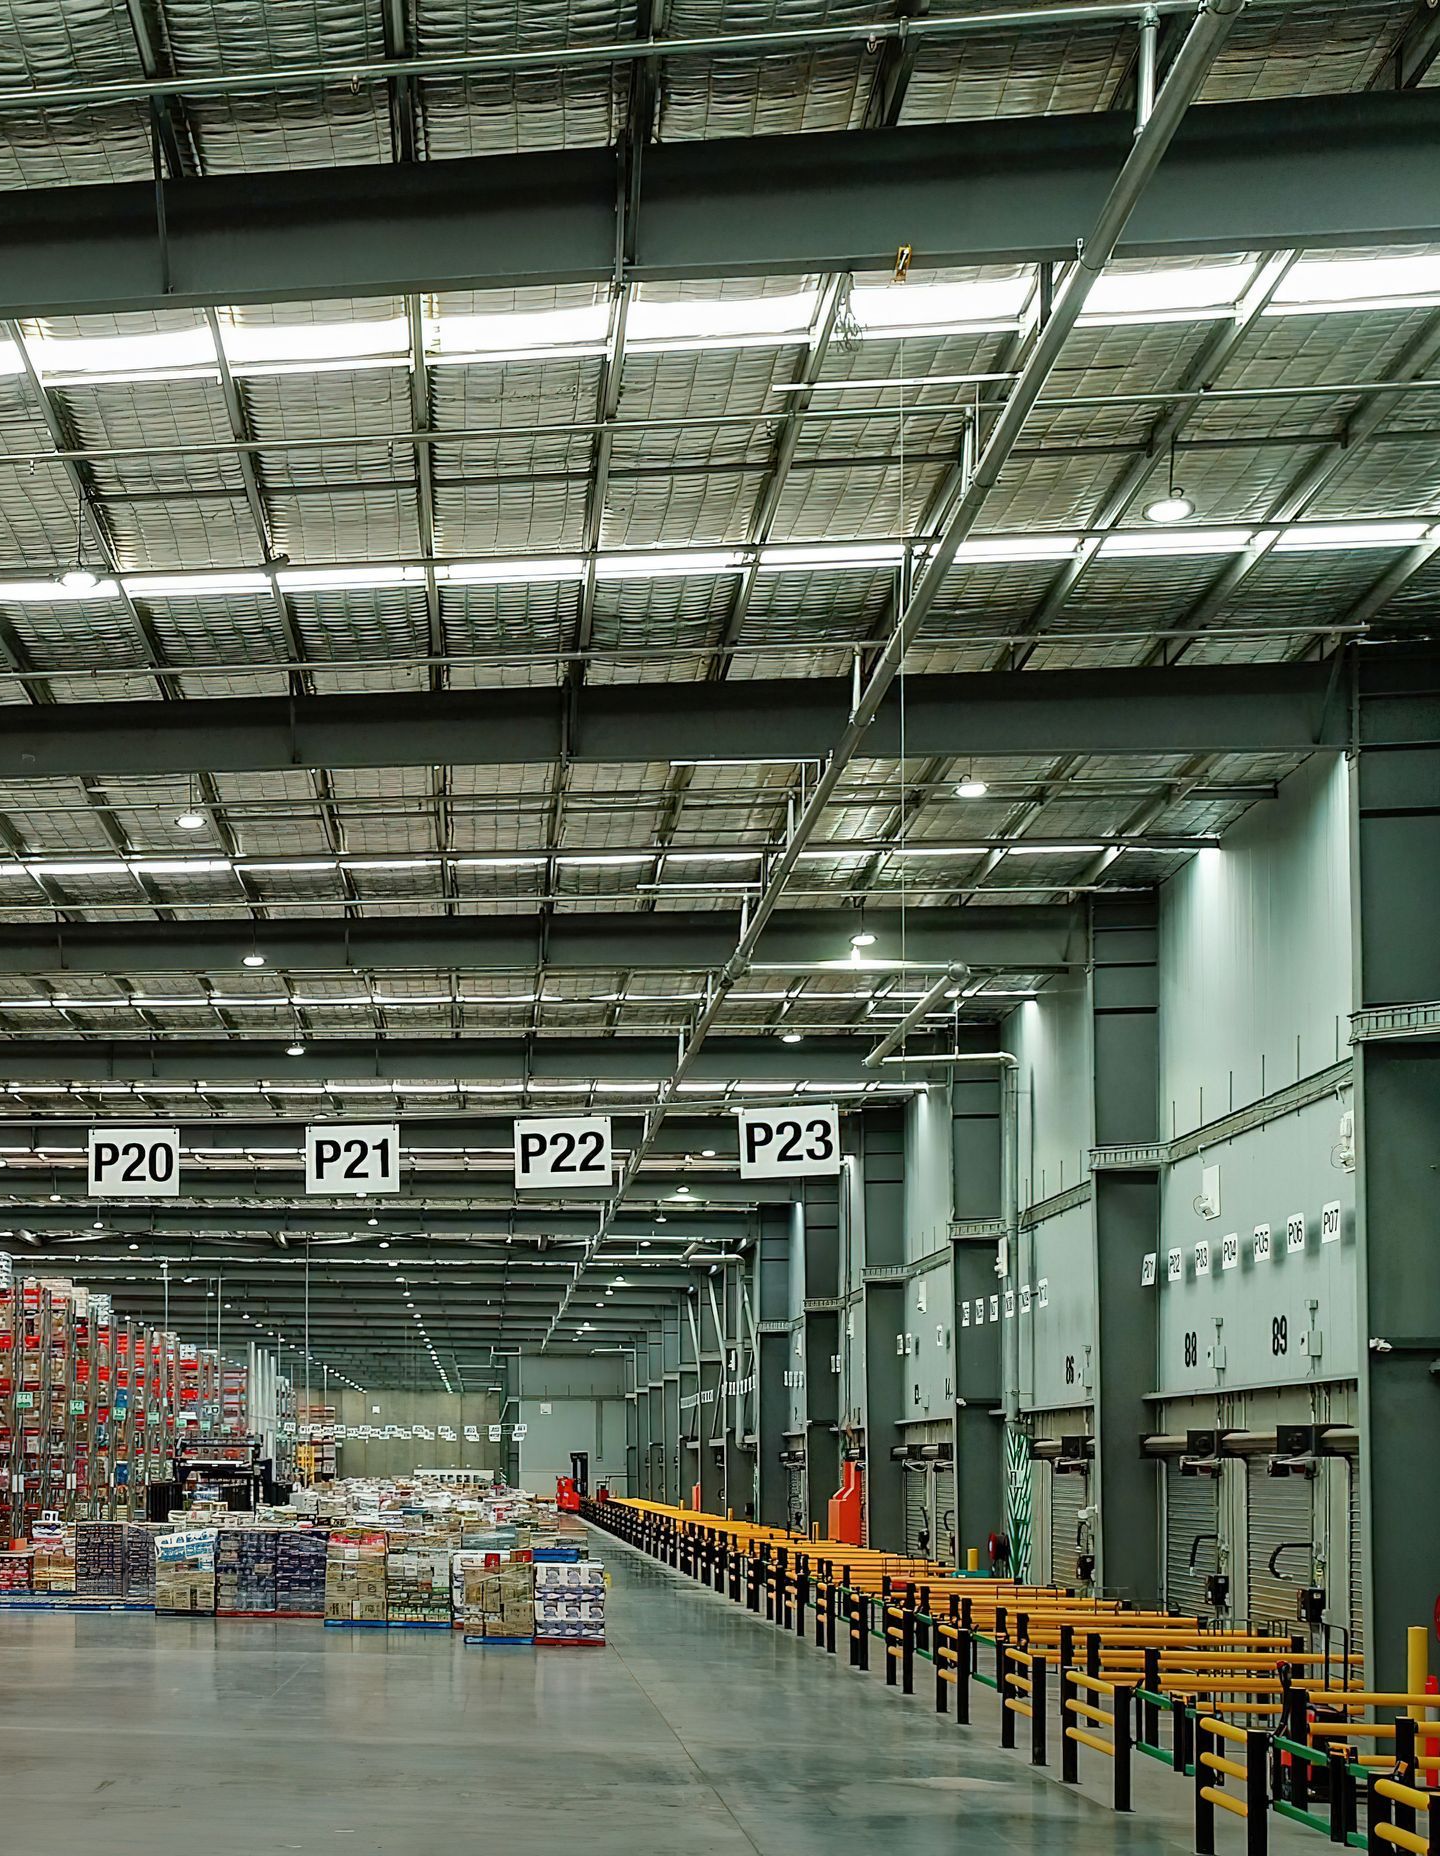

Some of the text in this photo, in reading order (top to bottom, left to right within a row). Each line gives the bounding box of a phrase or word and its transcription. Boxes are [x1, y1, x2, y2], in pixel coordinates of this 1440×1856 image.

[316, 1138, 390, 1179] P21
[520, 1131, 606, 1174] P22
[746, 1119, 834, 1164] P23
[94, 1143, 174, 1182] P20
[1288, 1220, 1303, 1246] P06
[1323, 1209, 1339, 1234] P07
[1185, 1331, 1198, 1368] 88
[1272, 1315, 1288, 1357] 89
